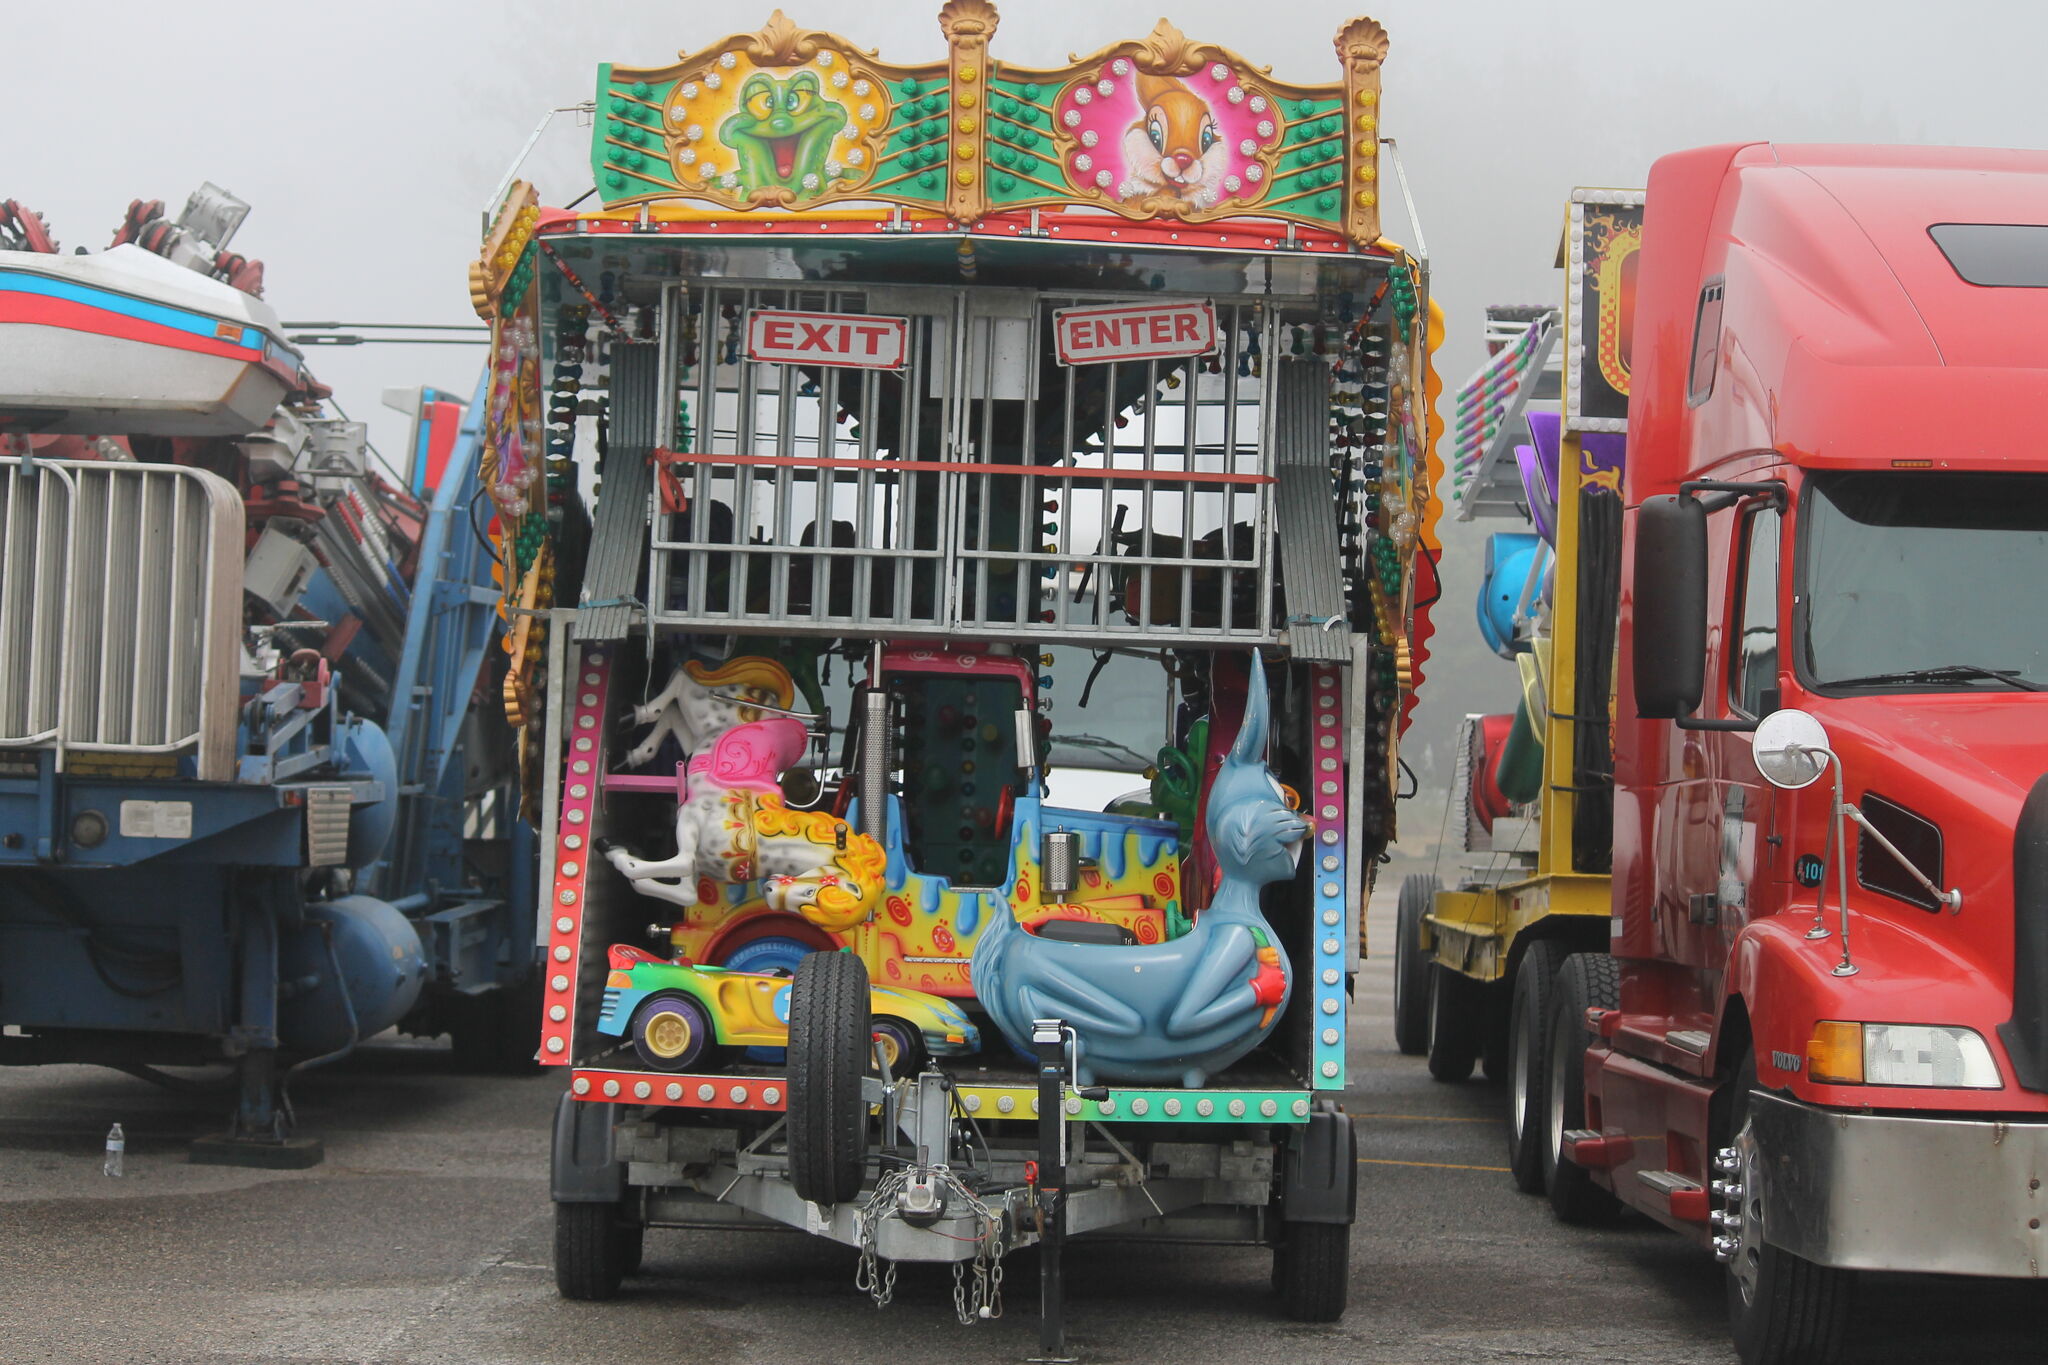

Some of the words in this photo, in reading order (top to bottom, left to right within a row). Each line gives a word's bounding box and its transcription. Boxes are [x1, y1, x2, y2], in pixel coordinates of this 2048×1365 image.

[763, 320, 890, 355] EXIT
[1069, 313, 1201, 350] ENTER
[1772, 1050, 1802, 1072] VOLVO
